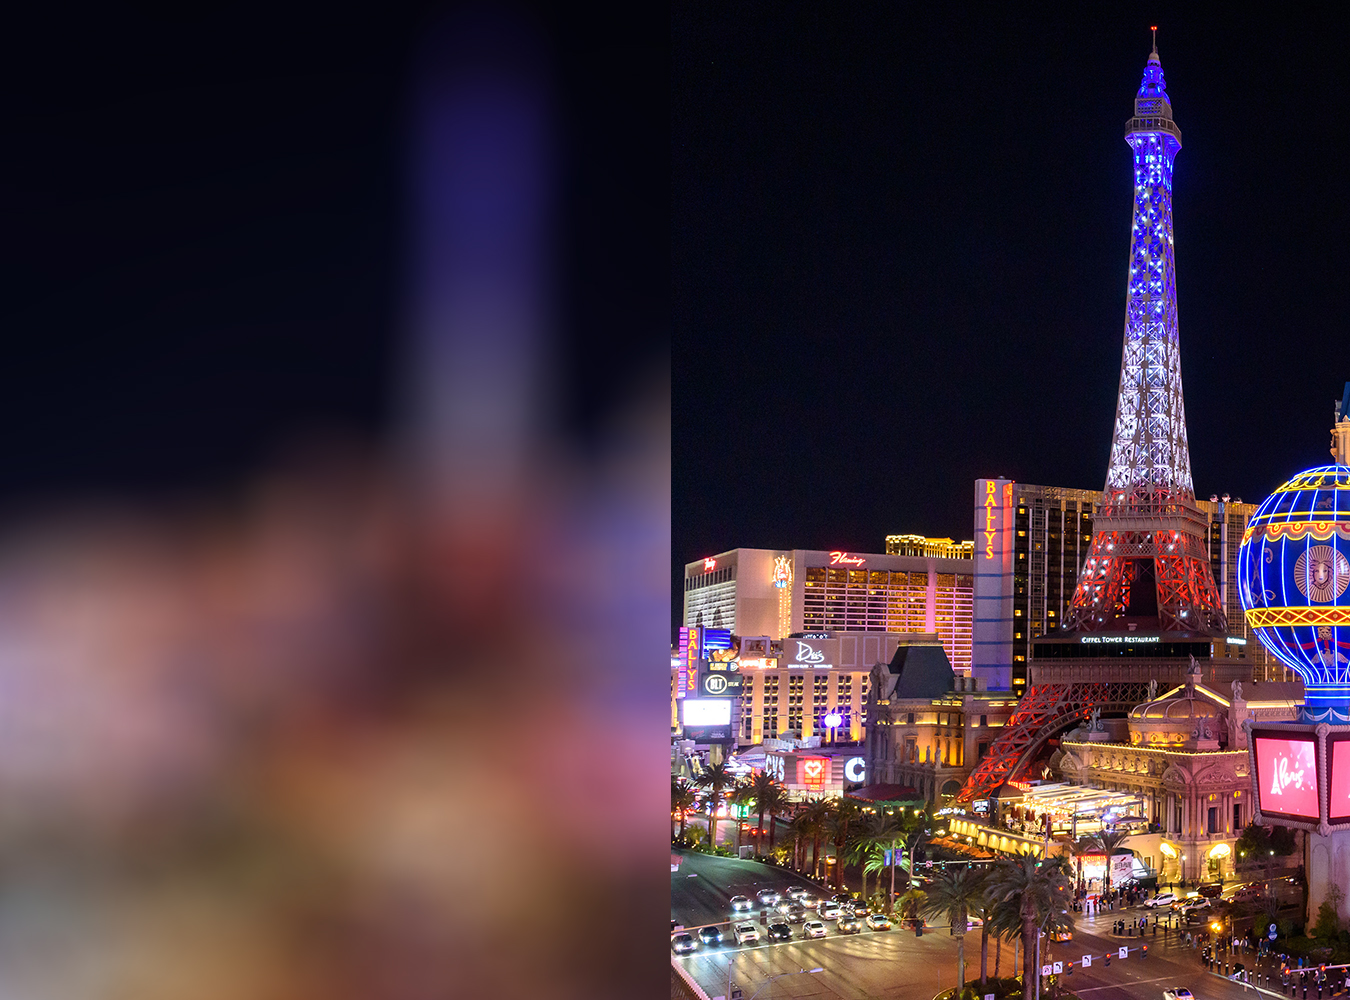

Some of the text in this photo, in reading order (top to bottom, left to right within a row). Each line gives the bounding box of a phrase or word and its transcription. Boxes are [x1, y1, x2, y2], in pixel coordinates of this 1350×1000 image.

[983, 480, 998, 560] BALLYS
[710, 679, 723, 690] BLT
[765, 755, 785, 782] CVS
[1279, 757, 1304, 789] Paris
